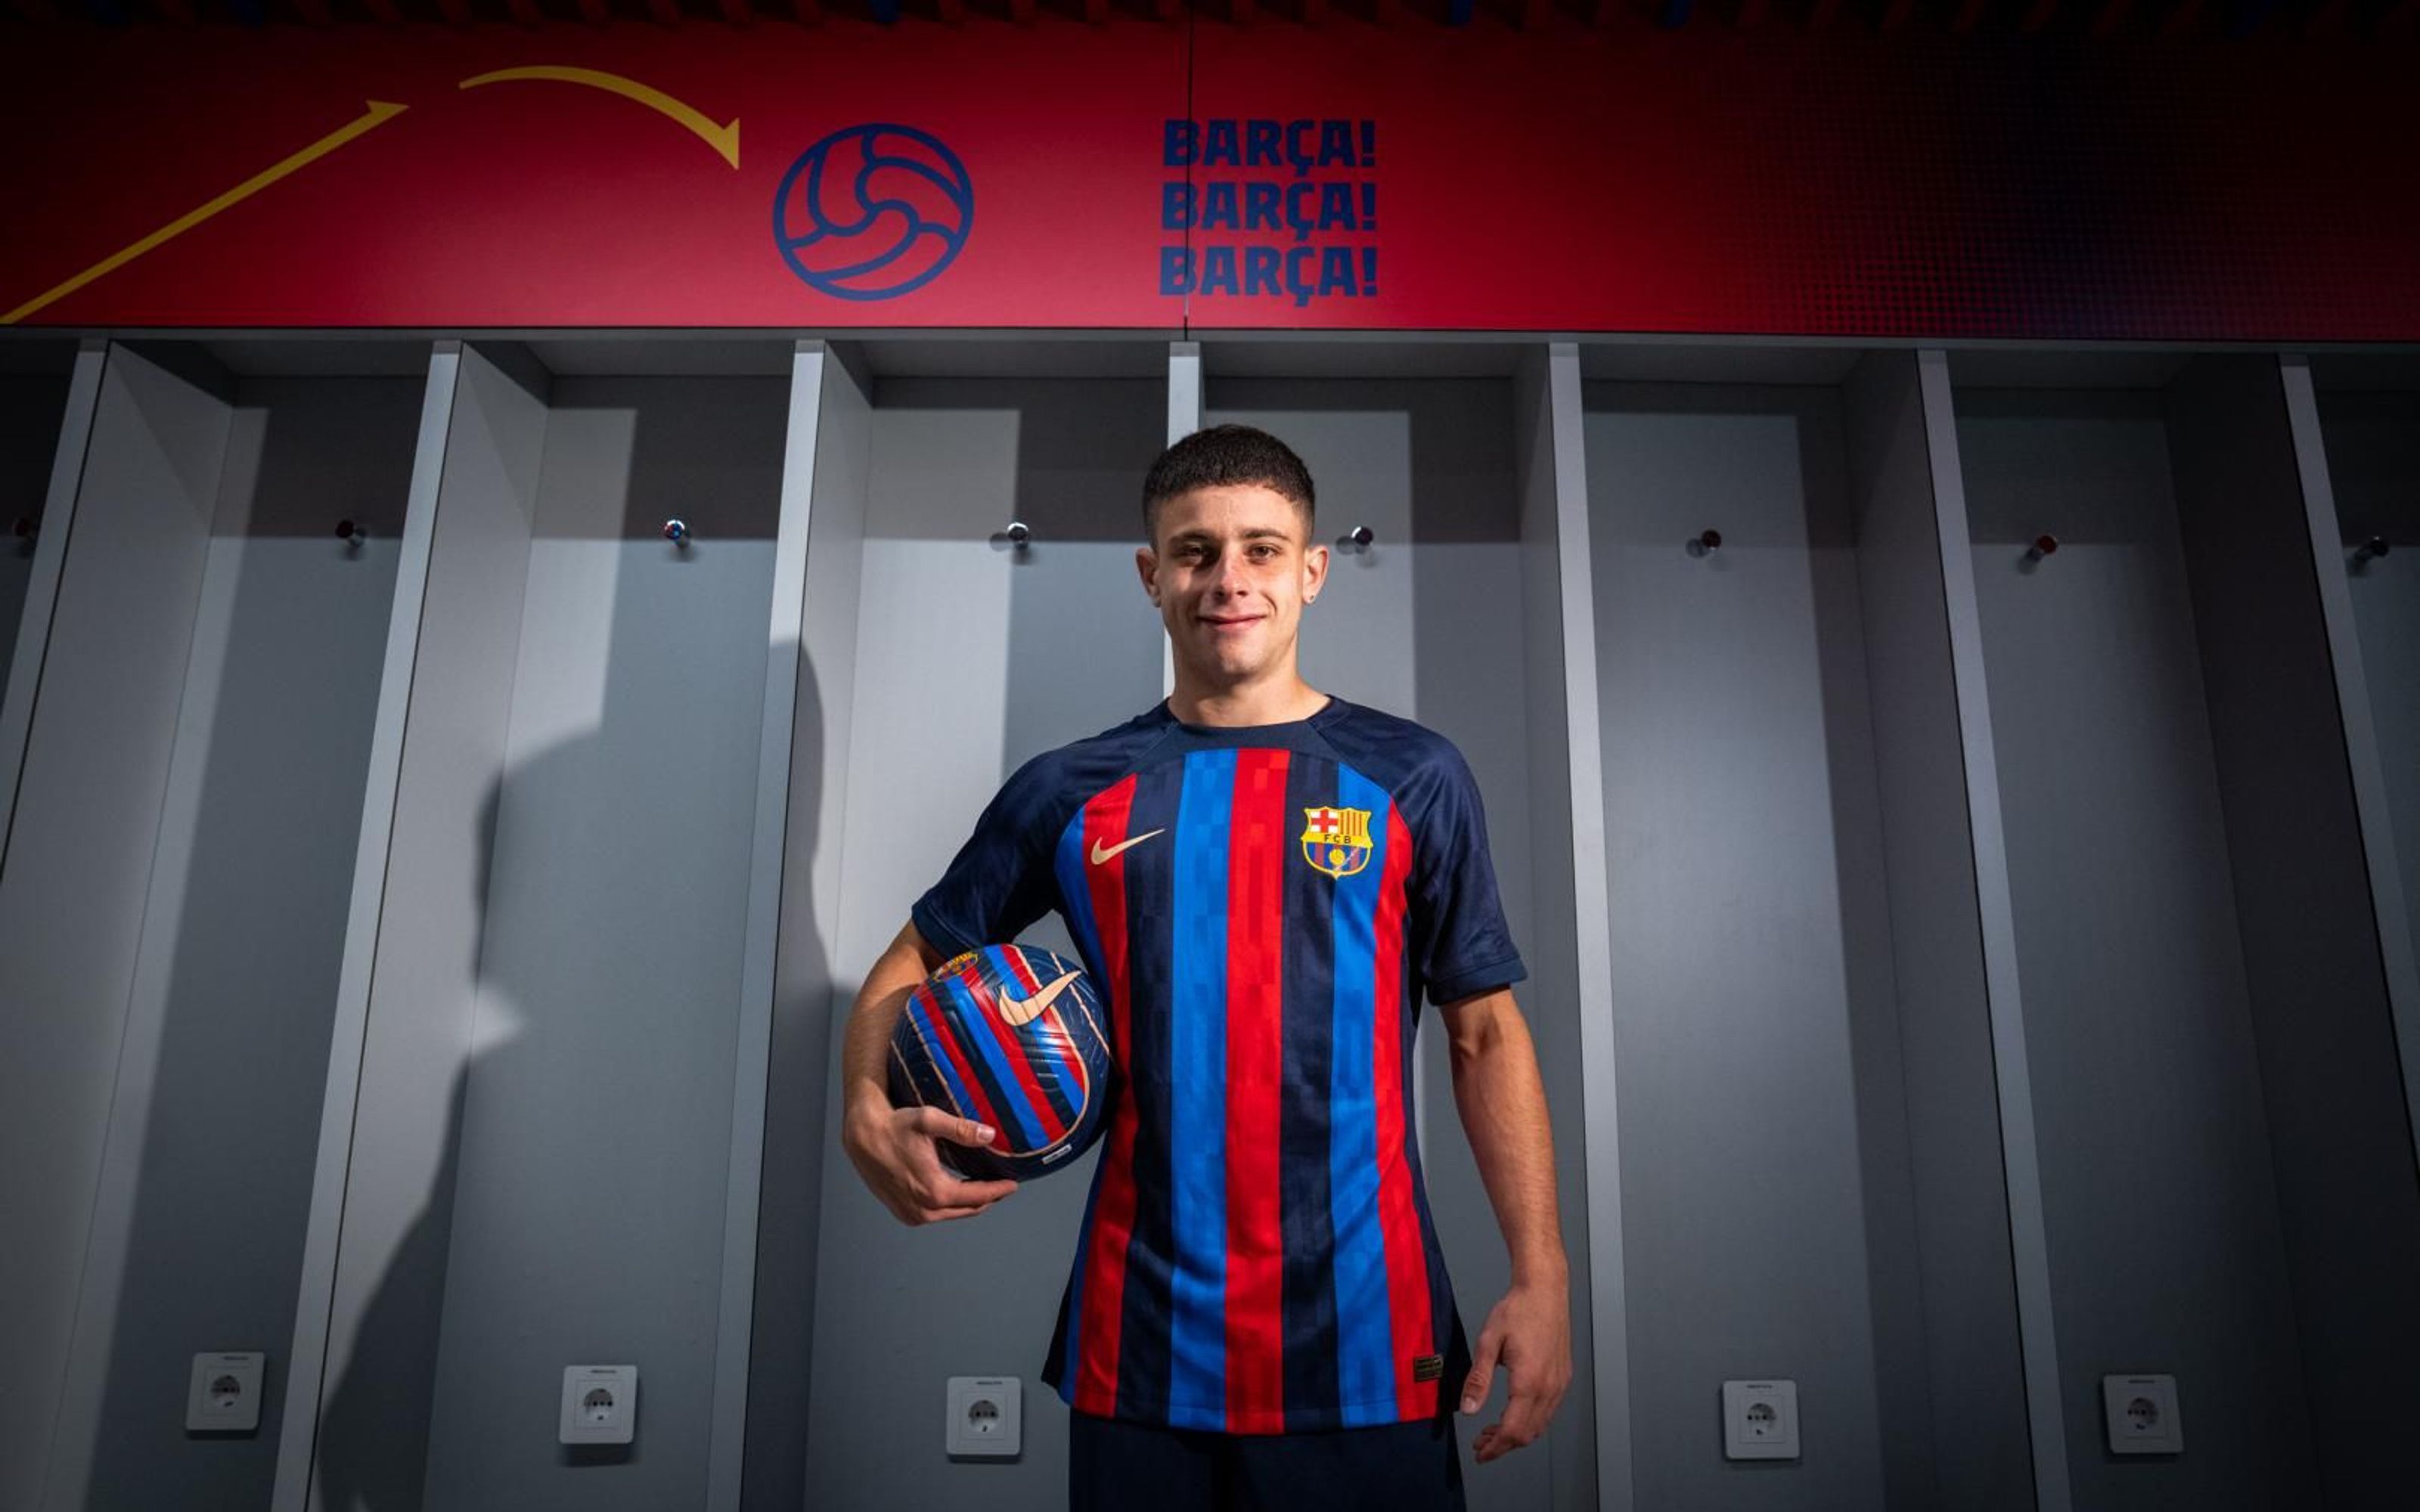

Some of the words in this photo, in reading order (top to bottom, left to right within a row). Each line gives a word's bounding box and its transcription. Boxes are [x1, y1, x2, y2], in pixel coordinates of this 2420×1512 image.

[1162, 119, 1376, 177] BARÇA!
[1162, 183, 1376, 242] BARÇA!
[1159, 246, 1377, 307] BARÇA!
